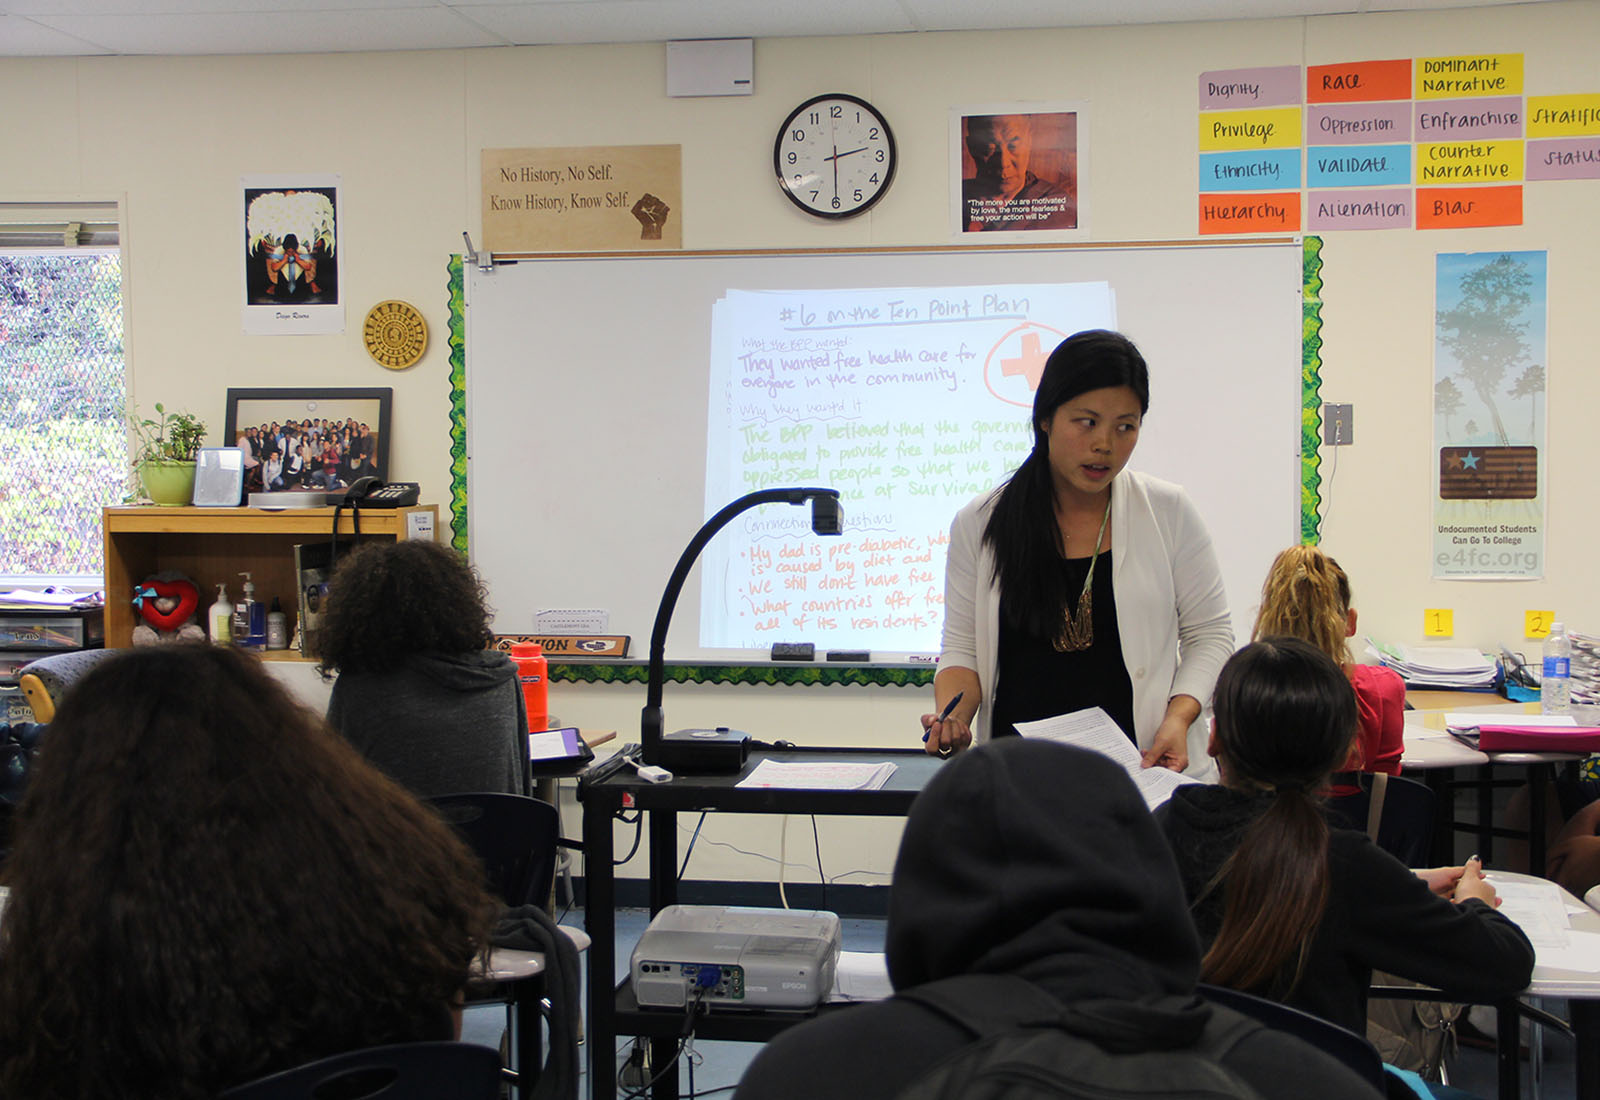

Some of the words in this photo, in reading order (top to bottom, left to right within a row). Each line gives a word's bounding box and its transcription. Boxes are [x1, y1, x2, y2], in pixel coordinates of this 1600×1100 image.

[810, 112, 819, 125] 11
[830, 105, 842, 118] 12
[856, 111, 860, 123] 1
[792, 129, 805, 142] 10
[869, 127, 878, 140] 2
[787, 151, 797, 164] 9
[875, 149, 885, 162] 3
[501, 167, 517, 183] No
[521, 166, 565, 185] History,
[568, 165, 585, 181] No
[588, 164, 613, 180] Self.
[869, 172, 879, 185] 4
[490, 194, 522, 211] Know
[525, 193, 568, 213] History,
[570, 192, 603, 208] Know
[605, 191, 630, 207] Self.
[810, 190, 819, 202] 7
[831, 196, 841, 209] 6
[853, 189, 862, 202] 5
[985, 215, 1001, 223] your
[1002, 213, 1024, 221] action
[887, 299, 918, 320] Ten
[929, 299, 971, 321] Point
[983, 294, 1030, 316] Plan
[738, 353, 774, 379] They
[780, 352, 830, 370] wanted
[834, 351, 863, 371] free
[868, 349, 912, 365] health
[918, 350, 948, 363] care
[955, 342, 976, 364] for
[741, 376, 796, 399] everyone
[804, 375, 821, 388] in
[826, 373, 857, 389] the
[740, 403, 767, 428] Why
[739, 423, 771, 445] The
[780, 423, 813, 443] BPP
[826, 420, 889, 440] believed
[893, 421, 924, 438] that
[935, 419, 959, 436] the
[816, 444, 830, 461] to
[840, 440, 888, 466] provide
[895, 439, 922, 460] free
[933, 440, 981, 457] health
[743, 464, 819, 488] oppressed
[829, 463, 882, 486] people
[890, 465, 910, 478] so
[917, 460, 954, 479] that
[966, 460, 991, 475] we
[874, 483, 896, 499] at
[842, 512, 892, 527] uestions
[1438, 525, 1497, 534] Undocumented
[1499, 525, 1537, 534] Students
[1452, 536, 1468, 545] Can
[1470, 536, 1480, 545] Go
[1482, 536, 1491, 545] To
[1493, 536, 1522, 546] College
[750, 544, 772, 568] My
[779, 542, 805, 558] dad
[810, 543, 821, 556] is
[751, 563, 764, 577] is
[776, 558, 822, 574] caused
[835, 558, 856, 578] by
[864, 552, 895, 568] diet
[902, 548, 931, 564] and
[1436, 548, 1538, 571] e4fc.org
[749, 579, 773, 596] We
[784, 574, 807, 591] still
[864, 572, 900, 587] have
[909, 567, 936, 587] free
[802, 594, 872, 612] countries
[885, 590, 915, 610] offer
[924, 586, 946, 607] fre
[755, 617, 781, 631] all
[793, 613, 813, 631] of
[817, 616, 838, 630] its
[1433, 612, 1443, 632] 1
[1531, 616, 1547, 633] 2
